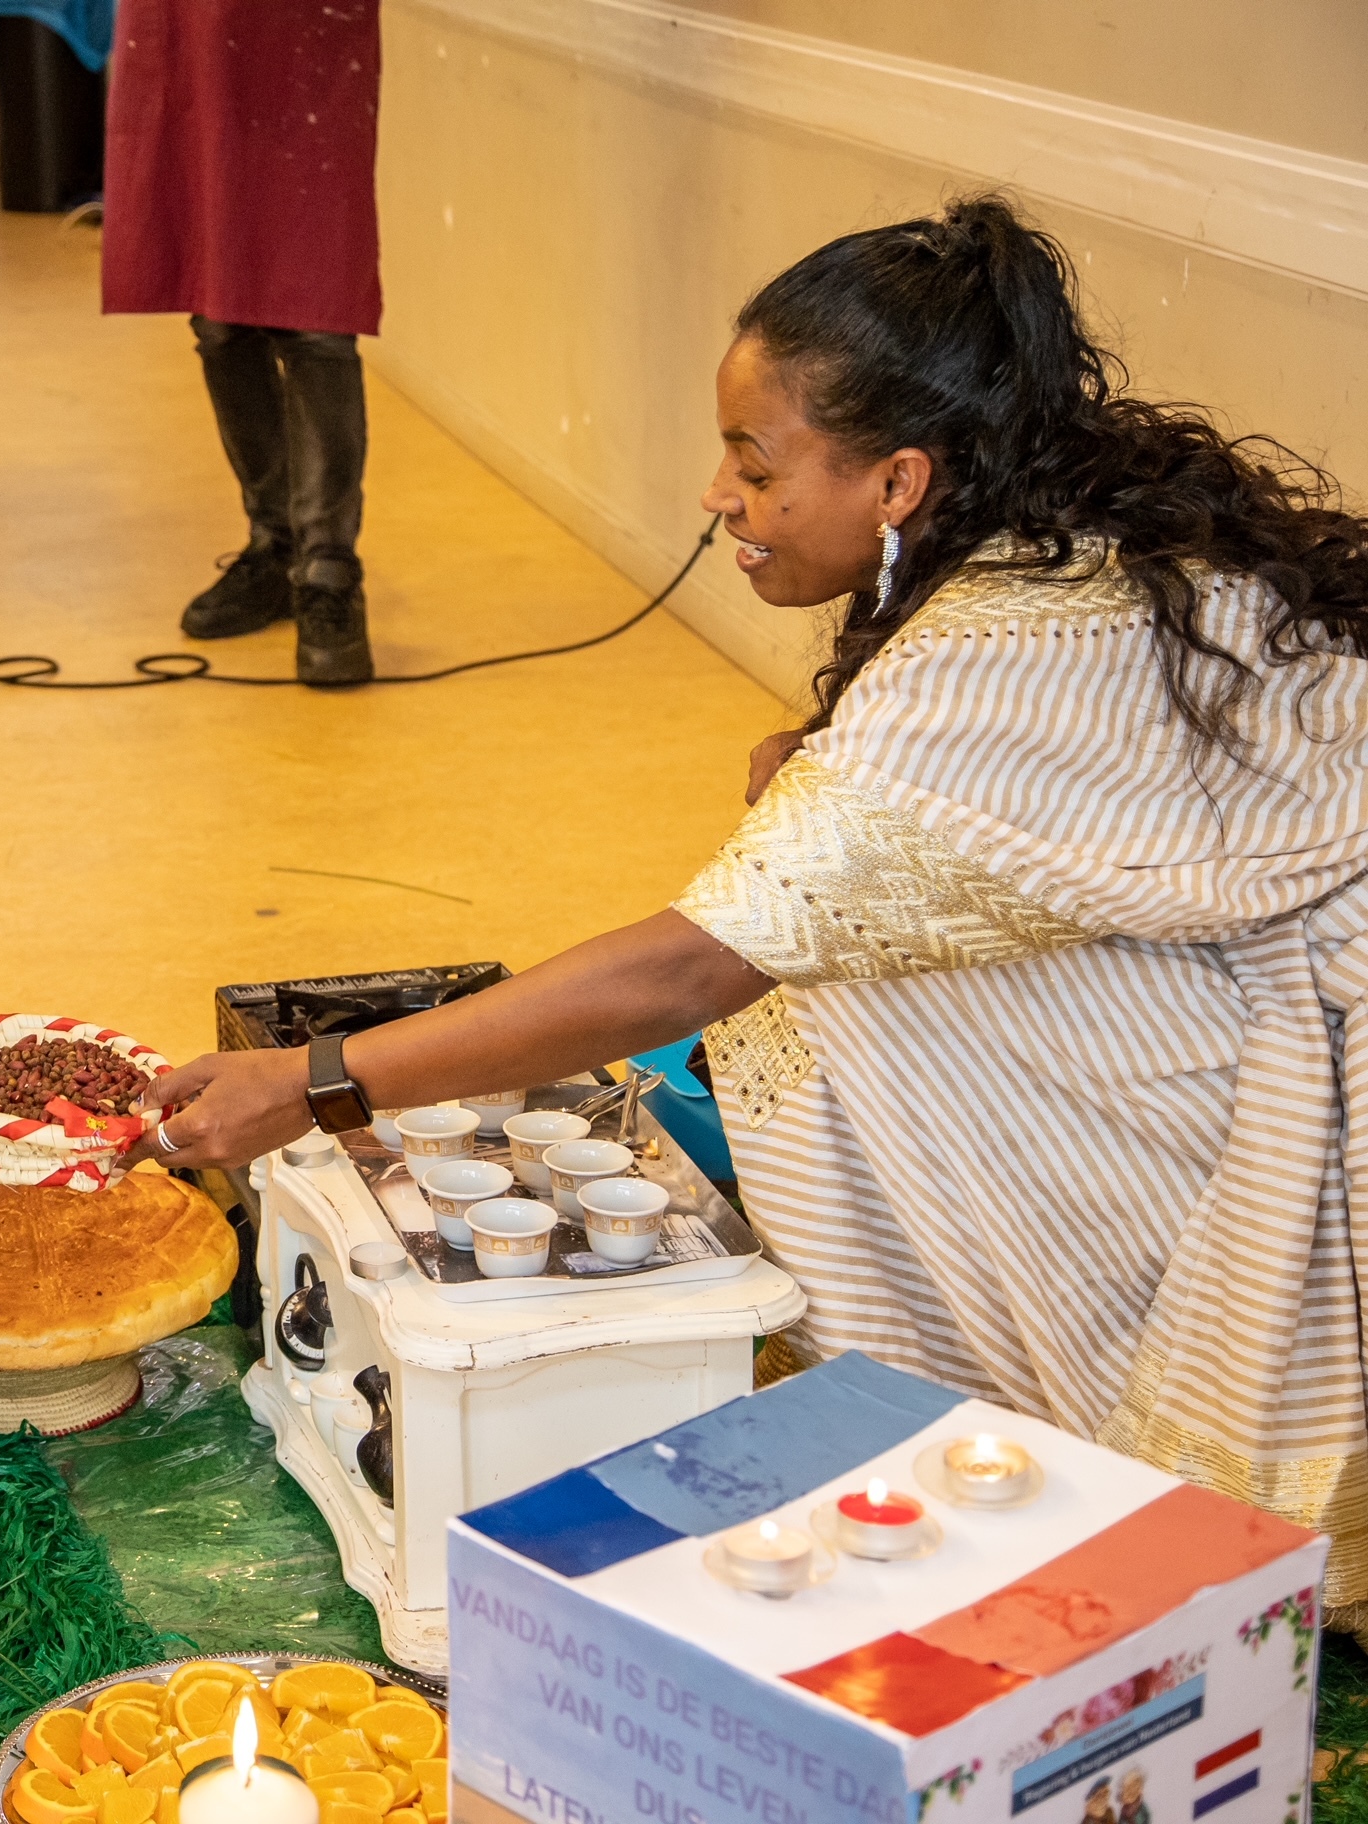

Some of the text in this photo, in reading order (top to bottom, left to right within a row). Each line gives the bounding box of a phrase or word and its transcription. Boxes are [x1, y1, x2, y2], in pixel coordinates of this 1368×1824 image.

[452, 1577, 604, 1679] VANDAAG
[615, 1655, 647, 1700] IS
[657, 1678, 701, 1730] DE
[711, 1704, 824, 1792] BESTE
[538, 1672, 808, 1824] VAN ONS LEVEN
